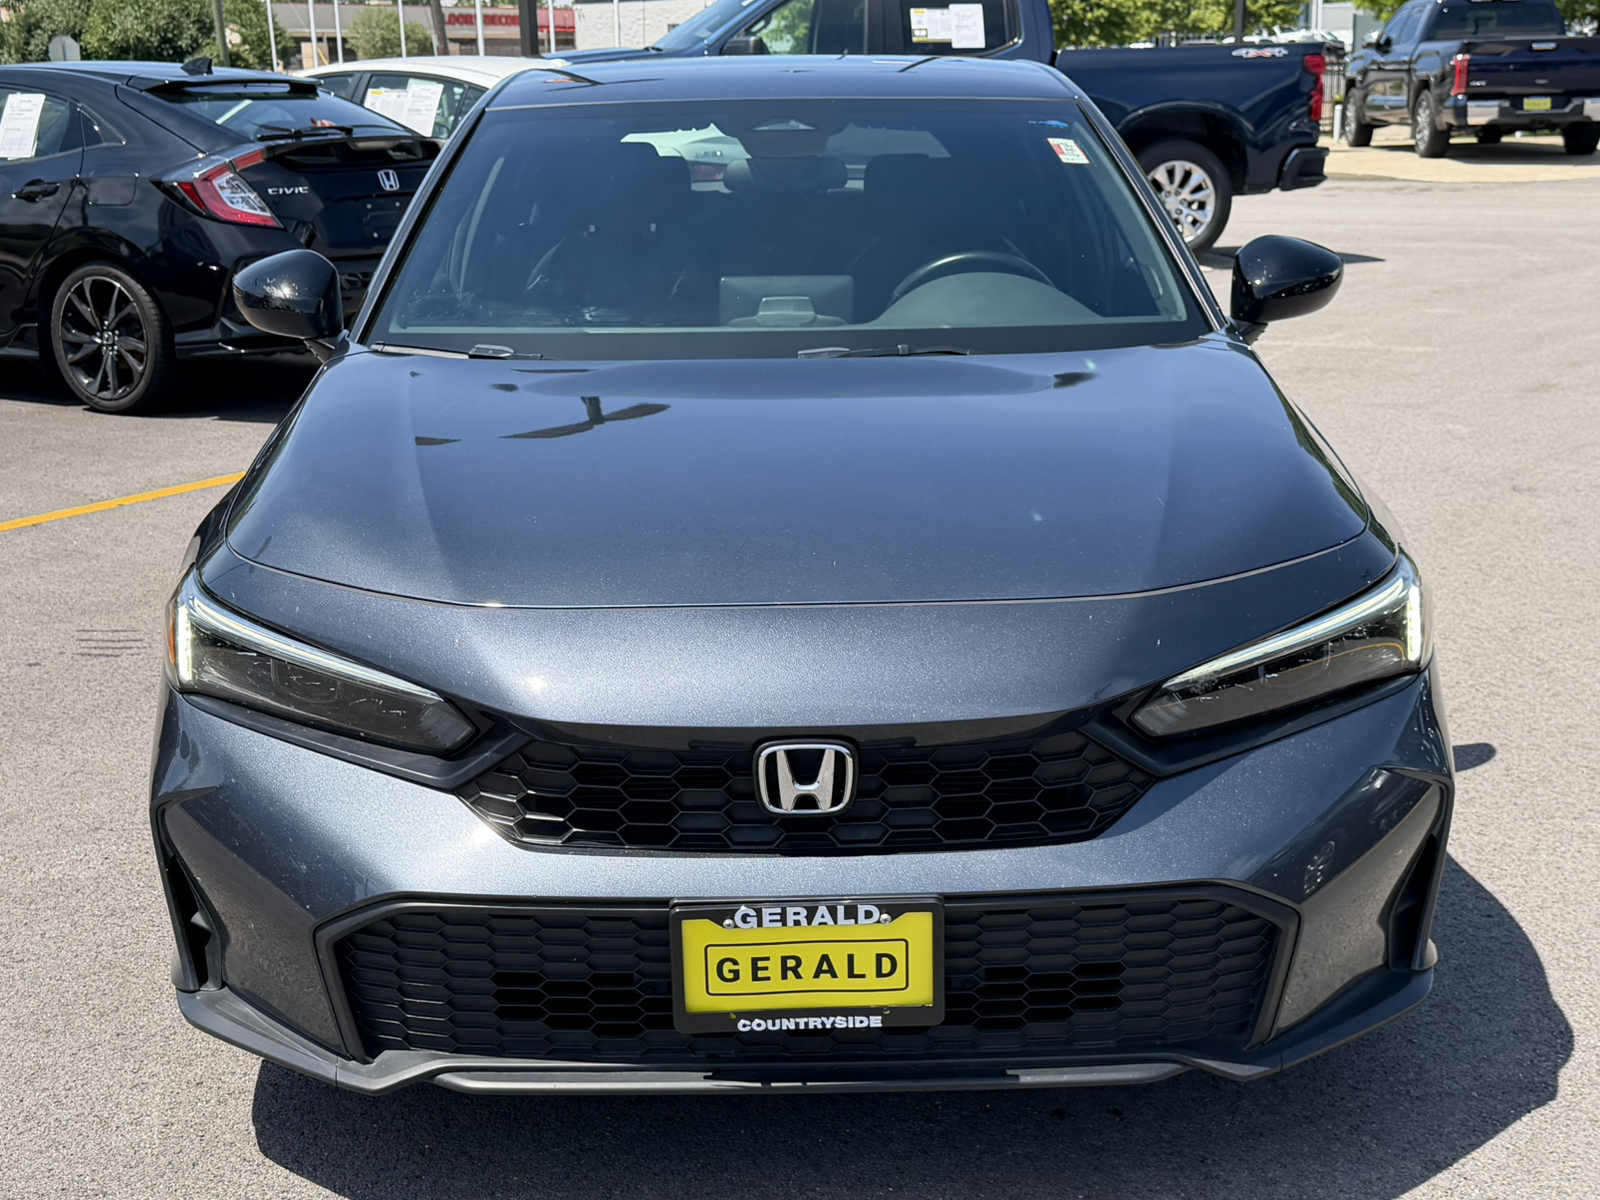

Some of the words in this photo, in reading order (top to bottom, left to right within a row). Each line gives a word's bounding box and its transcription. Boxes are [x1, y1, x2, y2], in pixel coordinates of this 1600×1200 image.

[267, 186, 309, 195] CIVIC
[733, 904, 881, 930] GERALD
[715, 952, 898, 983] GERALD
[737, 1015, 883, 1032] COUNTRYSIDE
